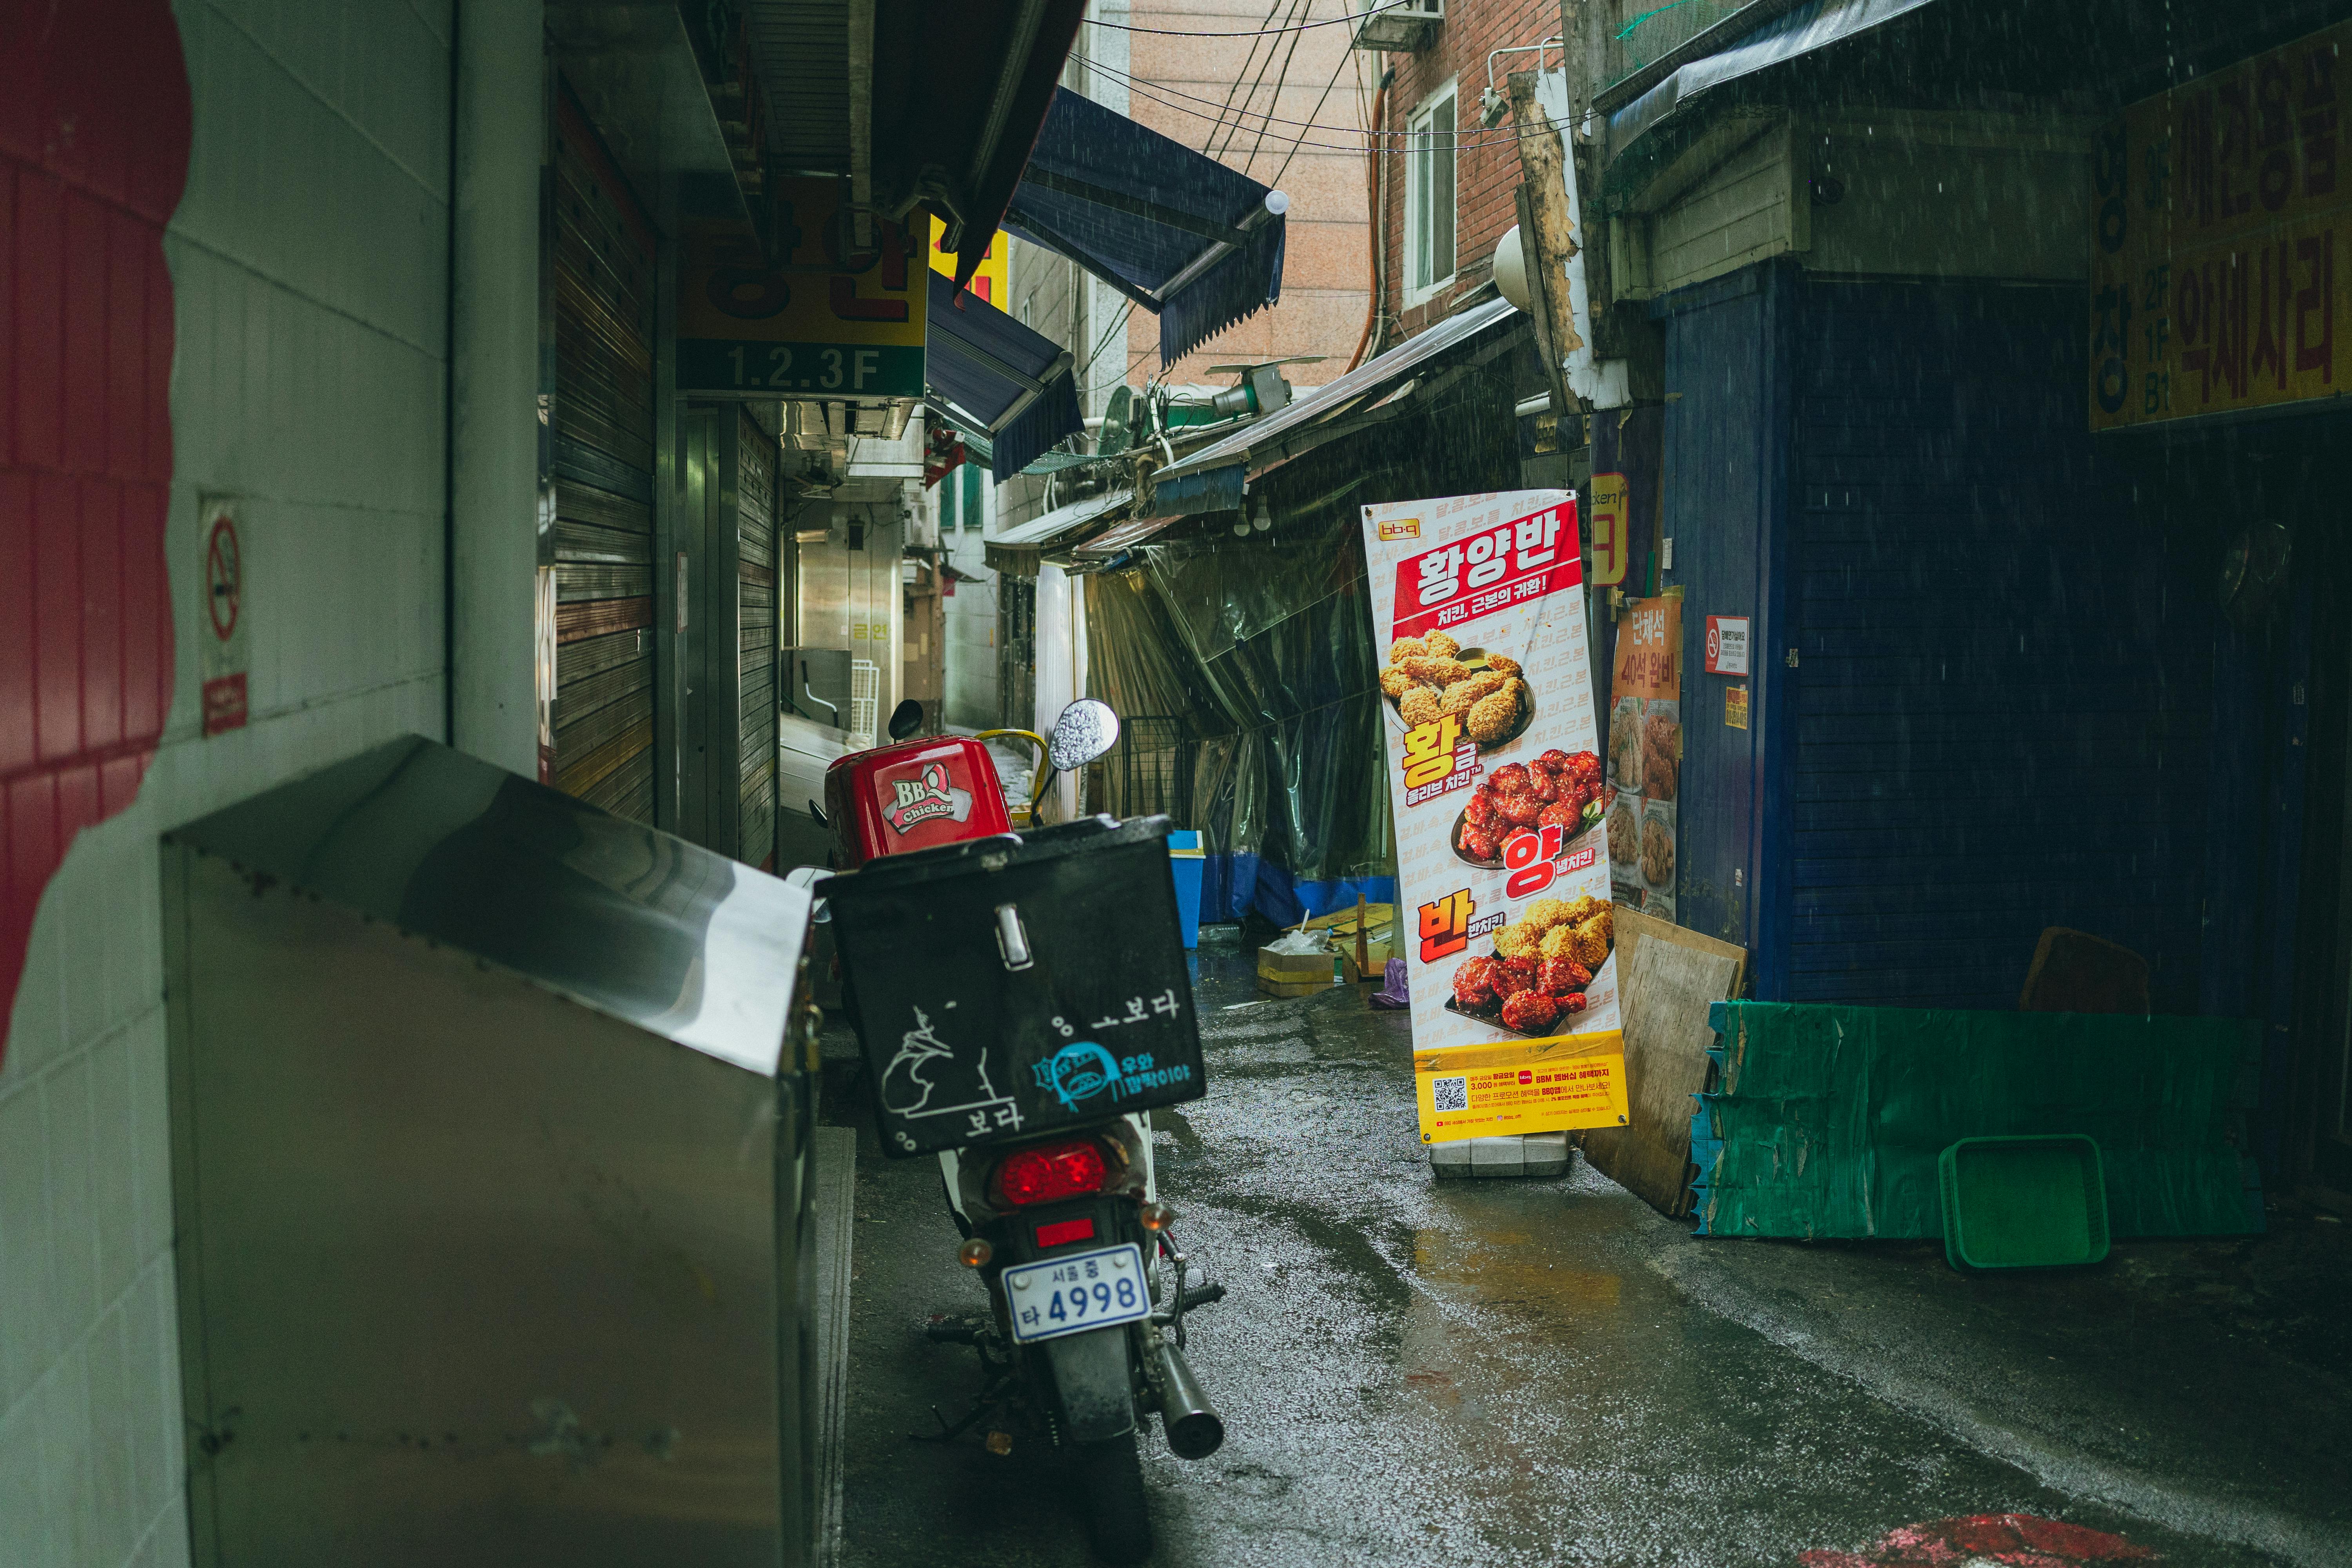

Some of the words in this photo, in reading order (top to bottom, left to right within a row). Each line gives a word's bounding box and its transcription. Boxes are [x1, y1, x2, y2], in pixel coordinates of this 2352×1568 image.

[2145, 264, 2170, 312] 2F
[2178, 229, 2334, 404] 악세사리
[2145, 371, 2170, 415] B1
[1418, 509, 1561, 606] 황양반
[1437, 603, 1468, 626] 치킨,
[1472, 587, 1511, 615] 근본의
[1514, 575, 1546, 599] 귀환!
[853, 623, 887, 640] 금연
[1632, 609, 1664, 646] 단체석
[1621, 652, 1646, 687] 40석
[1650, 652, 1674, 690] 완비
[1407, 780, 1443, 806] 올리브
[1608, 792, 1612, 801] 3
[1471, 1082, 1492, 1090] 3,000
[1472, 1093, 1491, 1102] 다양한
[1493, 1091, 1519, 1100] 프로모션
[1521, 1089, 1540, 1097] 혜택을
[1542, 1085, 1574, 1096] BBQ앱에서
[1575, 1081, 1610, 1092] 만나보세요!
[1536, 1075, 1552, 1083] BBM
[1554, 1072, 1577, 1082] 멤버십
[1579, 1068, 1610, 1079] 혜택까지
[965, 1102, 1025, 1137] 보다
[1053, 1265, 1079, 1282] 서울
[1021, 1305, 1041, 1326] 타
[1049, 1277, 1137, 1322] 4998
